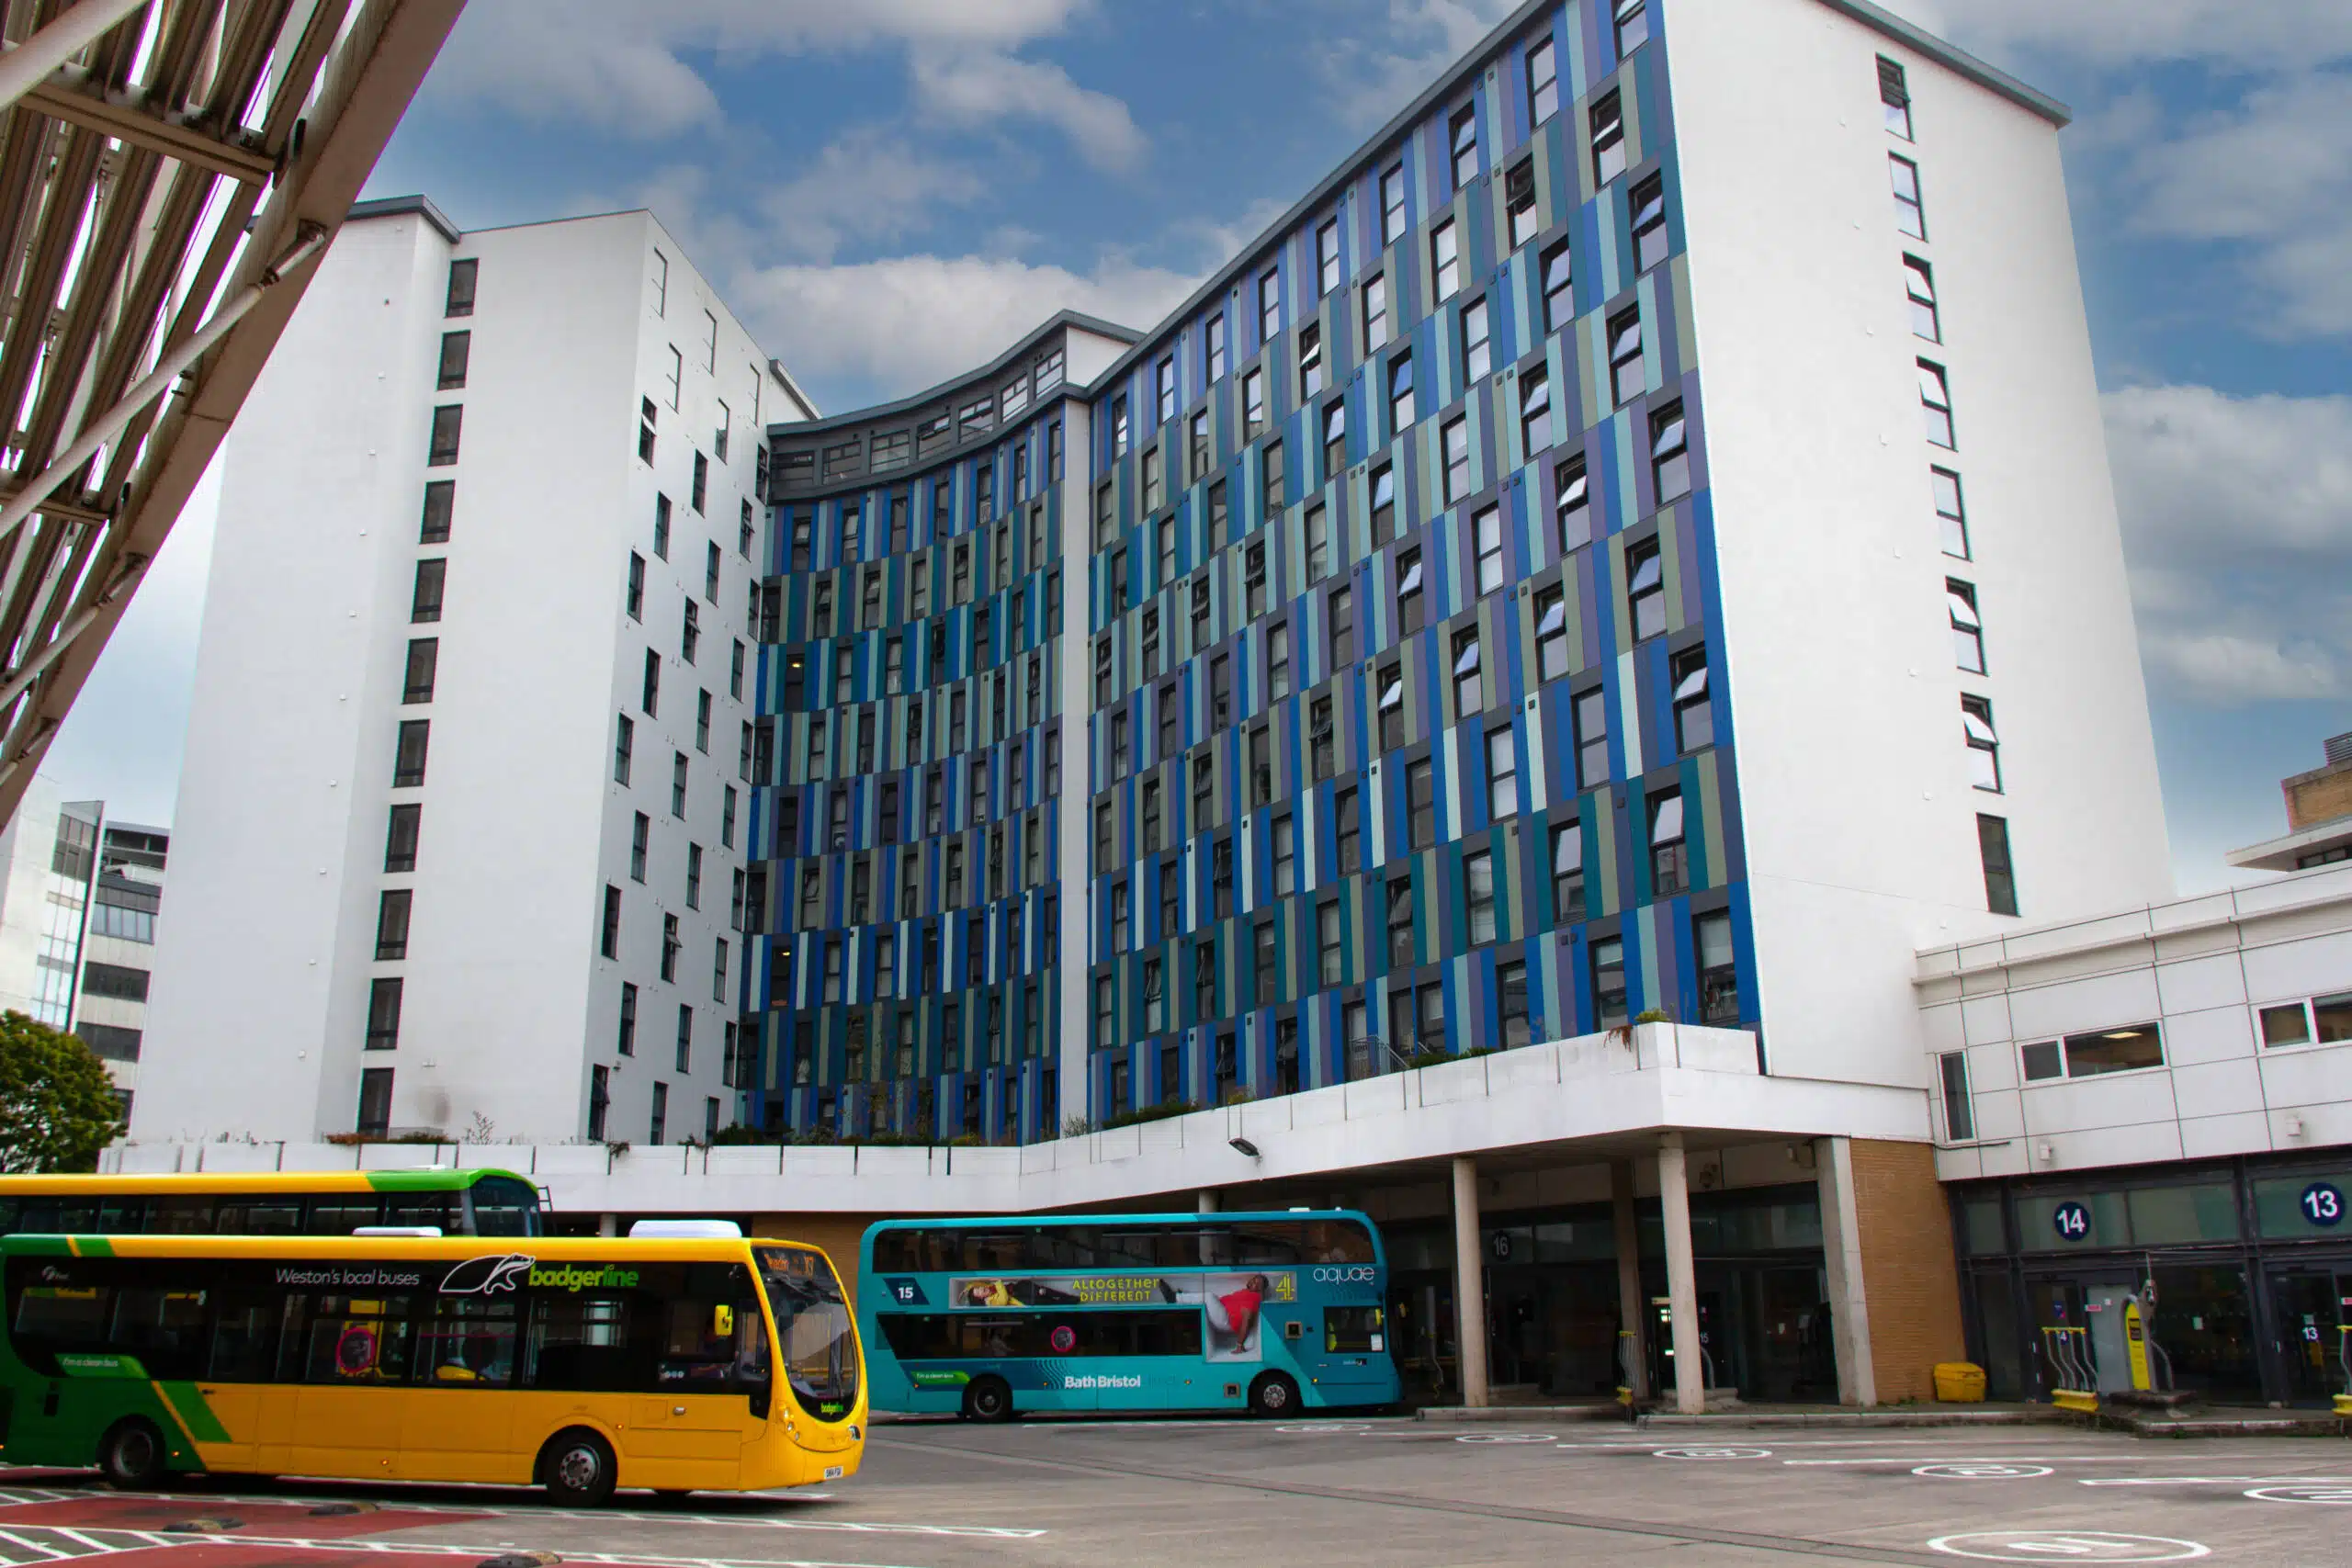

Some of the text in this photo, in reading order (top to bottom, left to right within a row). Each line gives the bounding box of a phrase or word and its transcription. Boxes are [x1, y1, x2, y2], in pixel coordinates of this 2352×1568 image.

[2304, 1190, 2338, 1218] 13
[2058, 1209, 2086, 1234] 14
[1493, 1235, 1509, 1256] 16
[276, 1268, 420, 1285] Weston's local buses
[529, 1264, 639, 1292] badgerline
[1313, 1268, 1374, 1285] aquae
[898, 1287, 914, 1299] 15
[2302, 1326, 2319, 1340] 13
[1065, 1374, 1141, 1389] Bath Bristol
